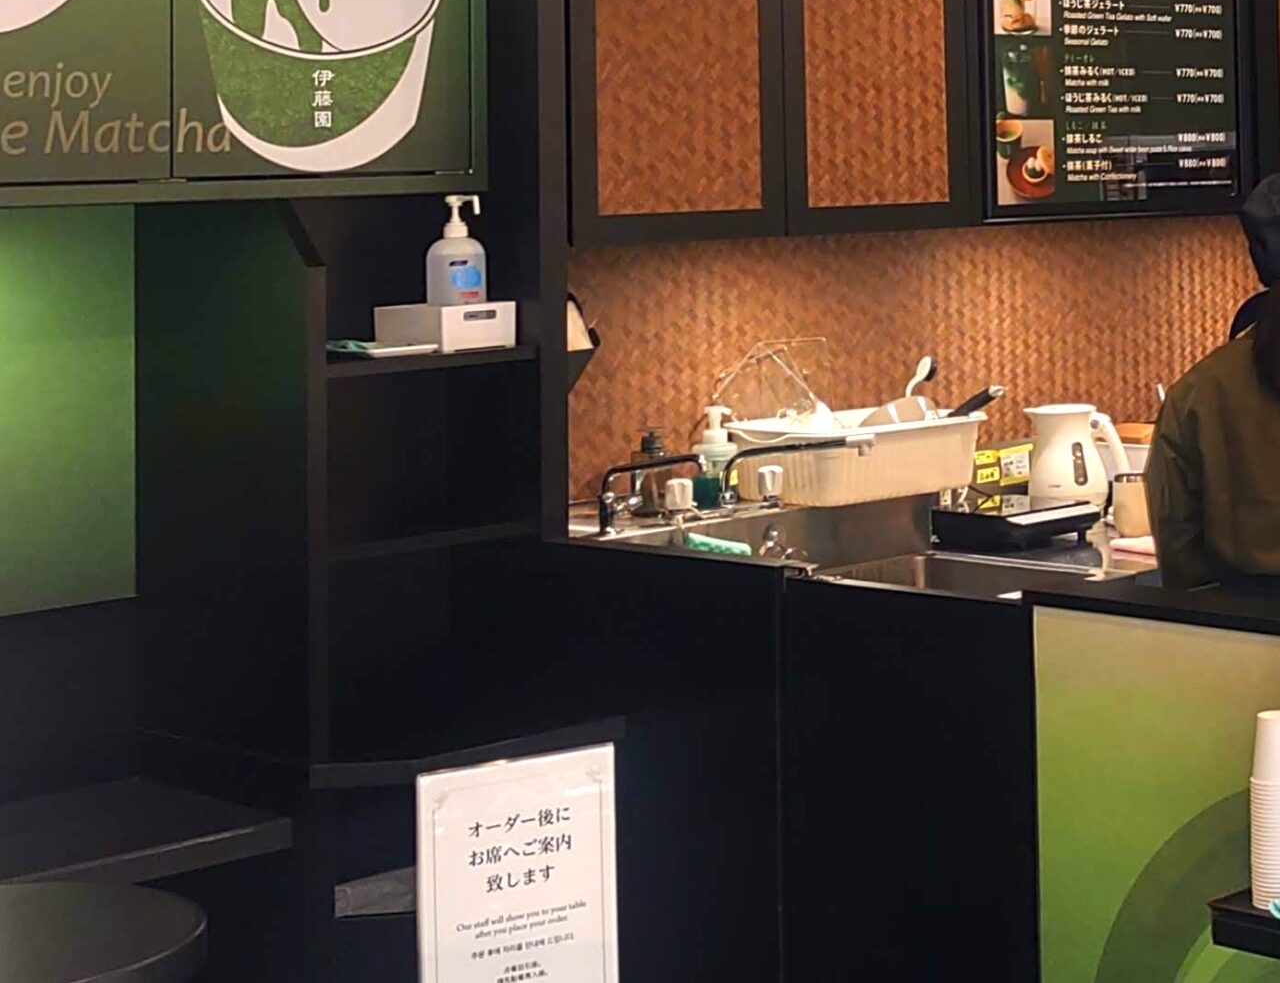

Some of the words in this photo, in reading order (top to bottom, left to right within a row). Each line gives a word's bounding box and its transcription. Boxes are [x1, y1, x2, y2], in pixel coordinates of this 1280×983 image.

[3, 62, 112, 108] enjoy
[312, 69, 336, 128] 伊藤園
[44, 108, 232, 154] Matcha
[468, 806, 571, 838] オーダー後に
[468, 833, 572, 868] お席へご案内
[485, 864, 555, 894] 致します
[456, 923, 472, 932] Our
[474, 918, 489, 929] staff
[491, 916, 504, 925] will
[506, 913, 525, 922] show
[526, 910, 540, 920] you
[541, 907, 549, 915] to
[551, 905, 567, 916] your
[569, 900, 587, 910] table
[475, 928, 492, 939] after
[493, 927, 507, 937] you
[508, 923, 528, 935] place
[529, 919, 546, 930] your
